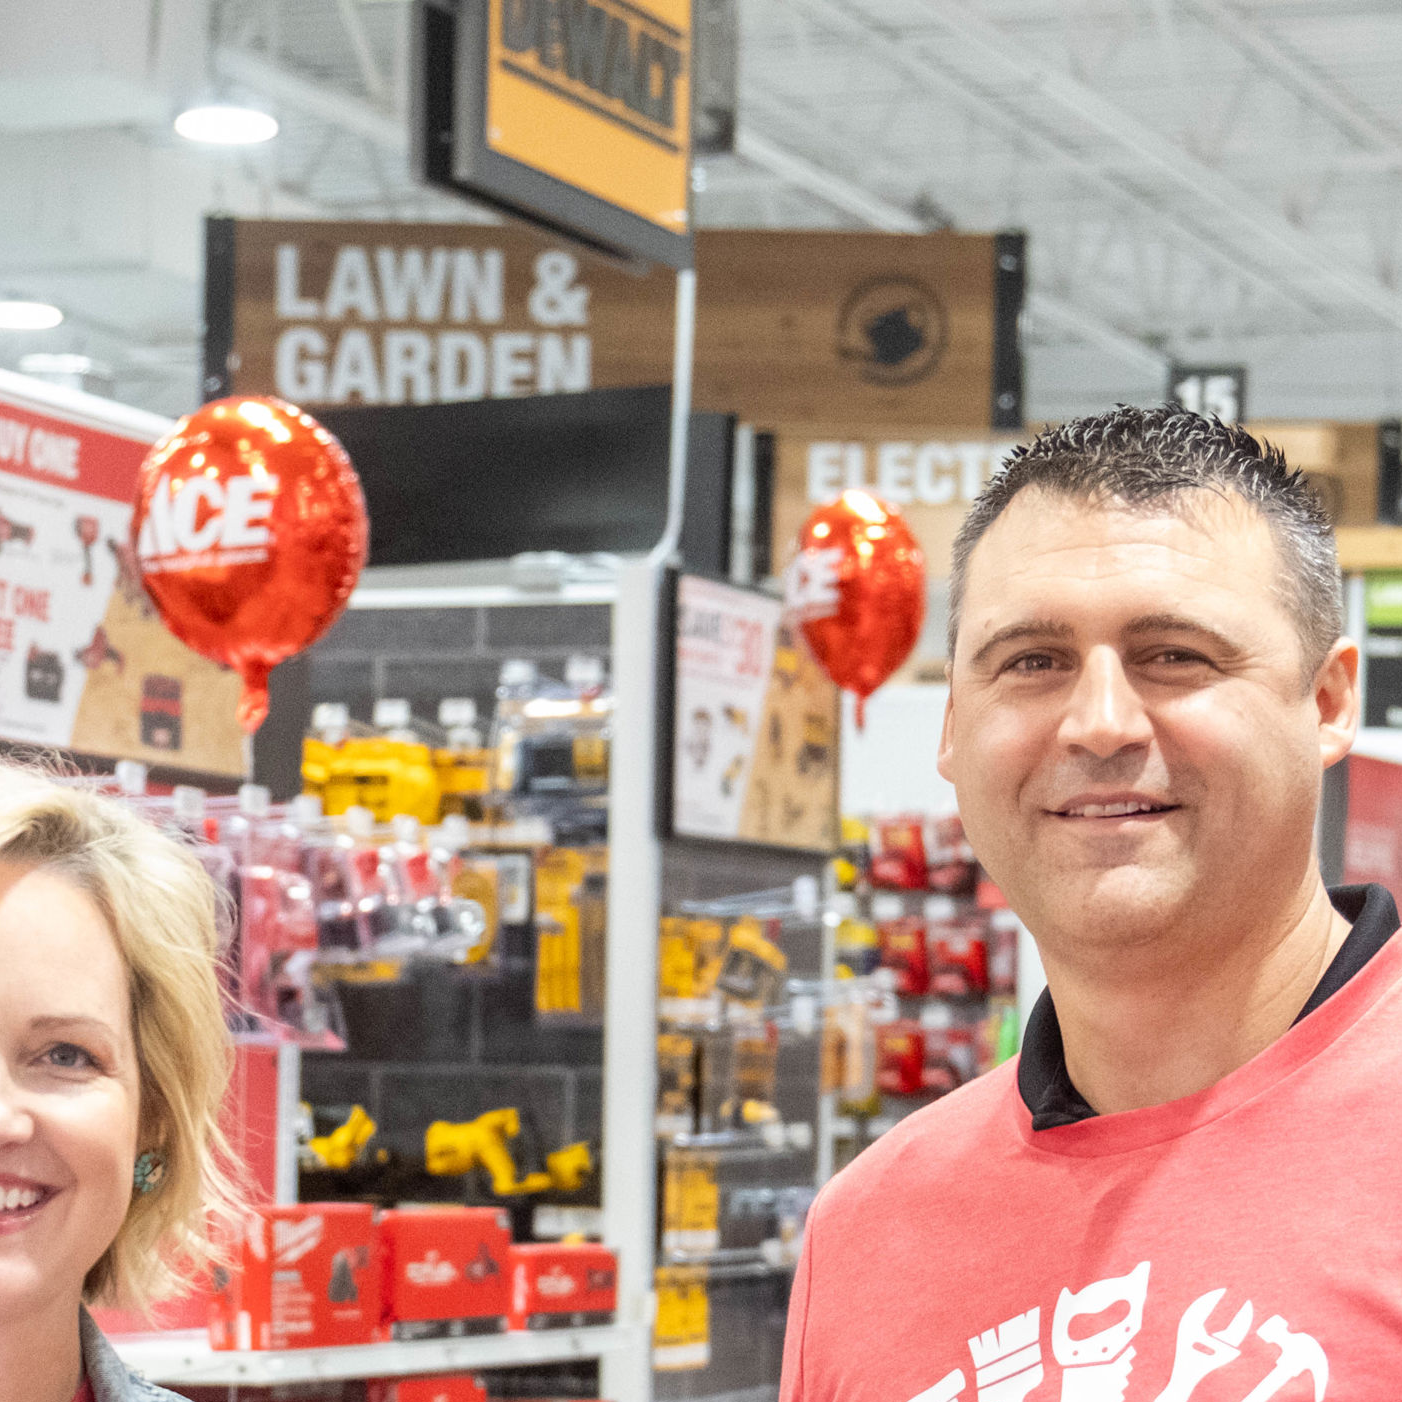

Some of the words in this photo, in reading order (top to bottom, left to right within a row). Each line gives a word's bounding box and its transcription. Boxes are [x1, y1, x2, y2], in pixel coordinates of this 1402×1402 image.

[275, 244, 504, 323] LAWN
[529, 250, 591, 326] &
[275, 330, 592, 406] GARDEN
[1174, 374, 1236, 425] 15
[29, 428, 80, 481] ONE
[138, 473, 280, 557] ACE
[784, 546, 845, 610] CE
